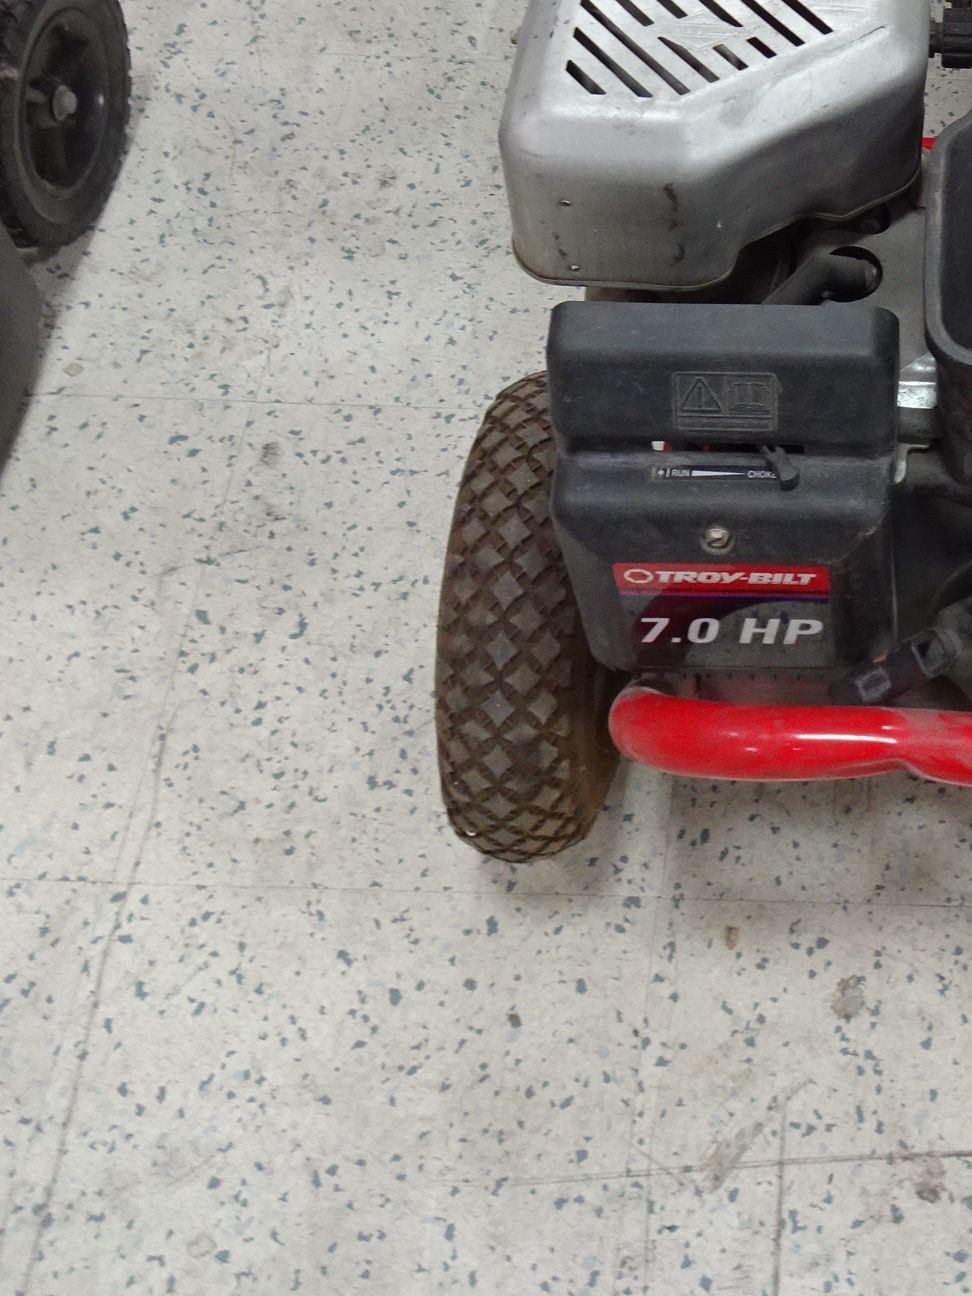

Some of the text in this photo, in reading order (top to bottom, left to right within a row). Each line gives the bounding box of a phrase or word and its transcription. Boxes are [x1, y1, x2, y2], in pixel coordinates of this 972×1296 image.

[670, 469, 691, 477] RUN
[654, 569, 817, 586] TROY-BILT
[640, 617, 824, 645] 7.0 HP
